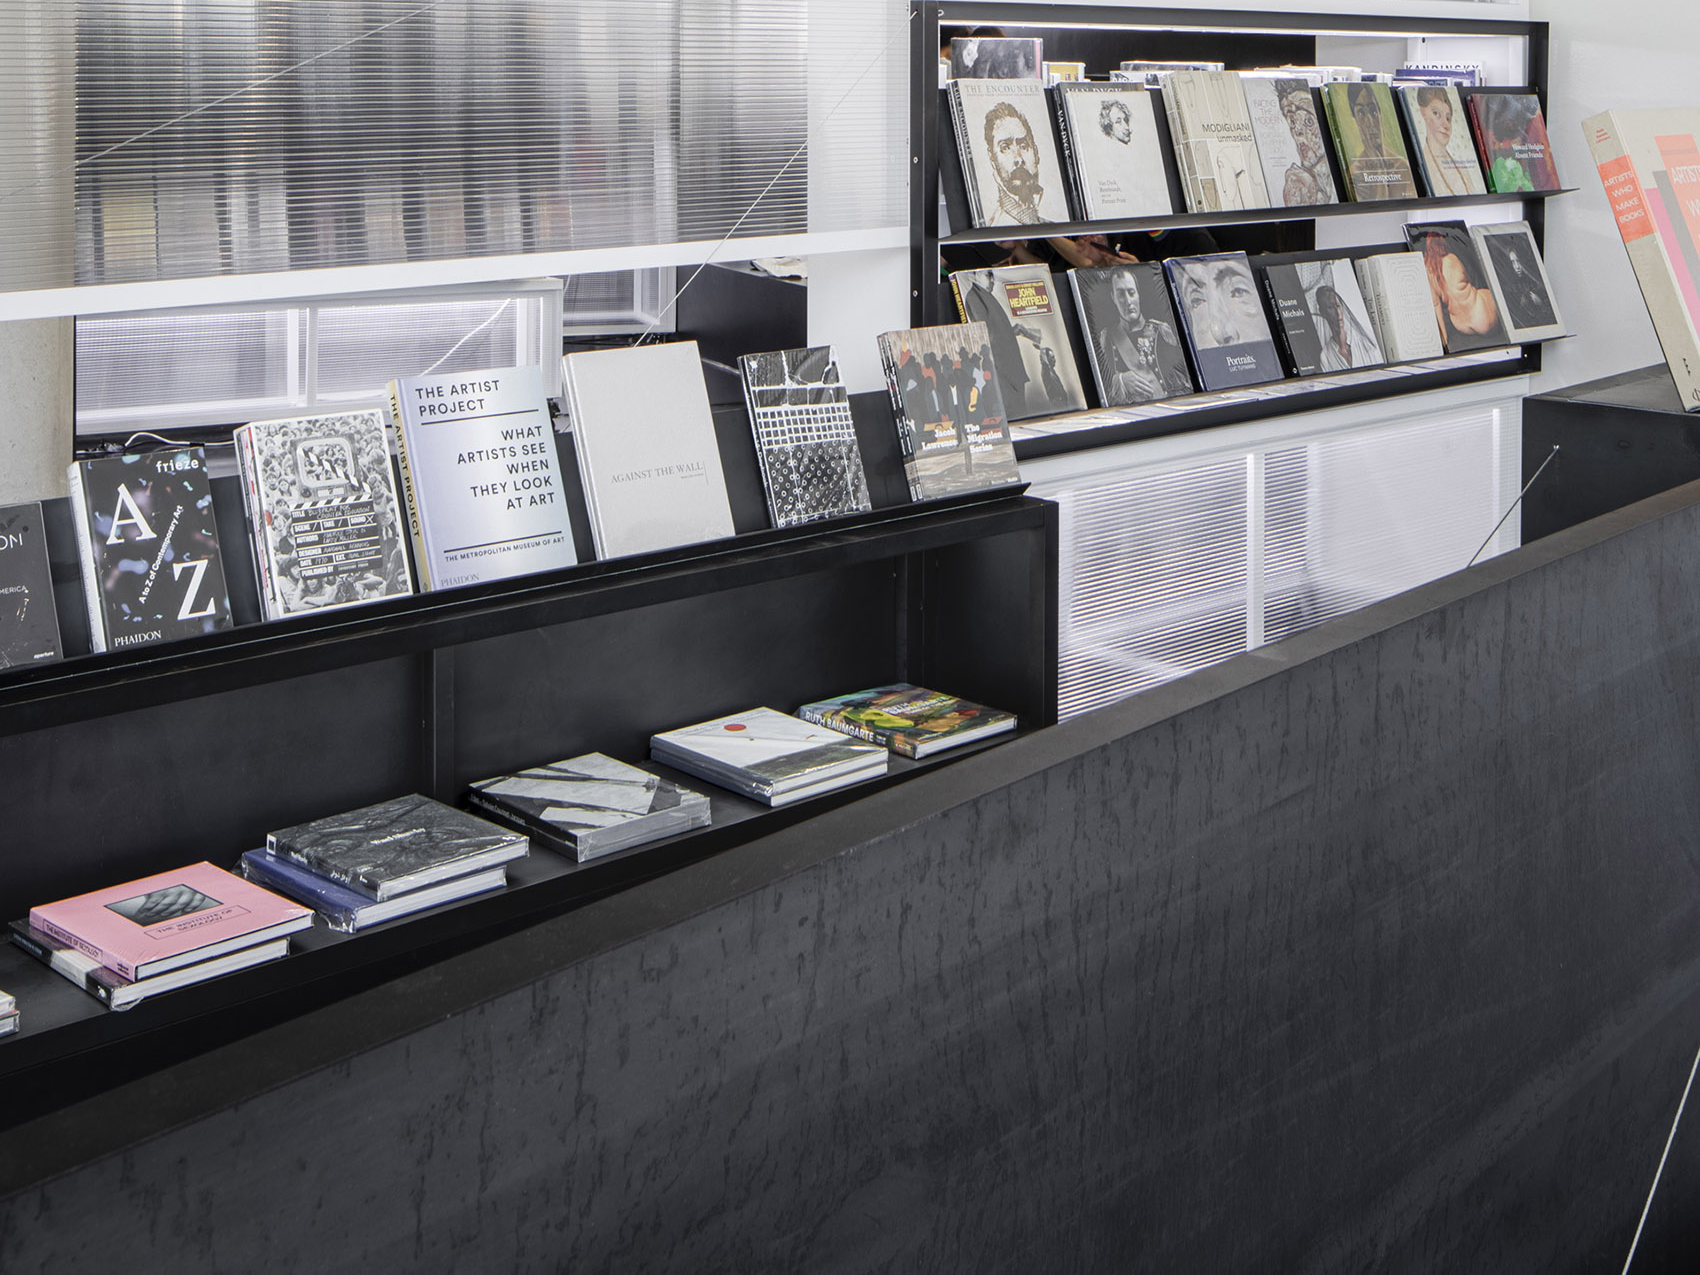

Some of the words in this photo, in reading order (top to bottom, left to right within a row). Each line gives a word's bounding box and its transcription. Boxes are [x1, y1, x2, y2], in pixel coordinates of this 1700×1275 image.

[1202, 123, 1250, 133] MODIGLIANI
[1217, 134, 1253, 143] unmasked
[1363, 172, 1402, 183] Retrospective
[1604, 171, 1634, 186] ARTISTS
[1612, 185, 1633, 197] WHO
[1615, 197, 1640, 211] MAKE
[1619, 209, 1645, 223] BOOKS
[1018, 287, 1036, 298] JOHN
[1009, 295, 1049, 307] HEARTFIELD
[1279, 299, 1297, 307] Duane
[1282, 308, 1305, 318] Michals
[415, 385, 445, 400] THE
[449, 380, 501, 396] ARTIST
[418, 398, 486, 417] PROJECT
[501, 425, 544, 441] WHAT
[934, 427, 956, 438] Jacob
[965, 423, 980, 433] The
[921, 439, 959, 451] Lawrence
[967, 431, 1003, 445] Migration
[457, 446, 518, 465] ARTISTS
[521, 442, 547, 456] SEE
[970, 442, 994, 454] Series
[156, 458, 199, 473] frieze
[389, 394, 400, 421] THE
[395, 425, 409, 472] ARTIST
[404, 476, 420, 538] PROJECT
[506, 458, 550, 475] WHEN
[611, 468, 653, 484] AGAINST
[655, 465, 675, 477] THE
[676, 461, 704, 474] WALL
[470, 481, 508, 498] THEY
[513, 475, 553, 491] LOOK
[506, 497, 523, 510] AT
[529, 492, 556, 507] ART
[106, 483, 157, 545] A
[151, 518, 180, 571] Contemporary
[174, 504, 184, 520] Art
[445, 554, 458, 563] THE
[459, 545, 512, 561] METROPOLITAN
[513, 540, 541, 551] MUSEUM
[542, 538, 551, 546] OF
[552, 536, 566, 545] ART
[440, 573, 480, 588] PHAIDON
[173, 559, 216, 620] Z
[114, 630, 162, 647] PHAIDON
[805, 710, 826, 726] RUTH
[826, 717, 874, 742] BAUMGARTE
